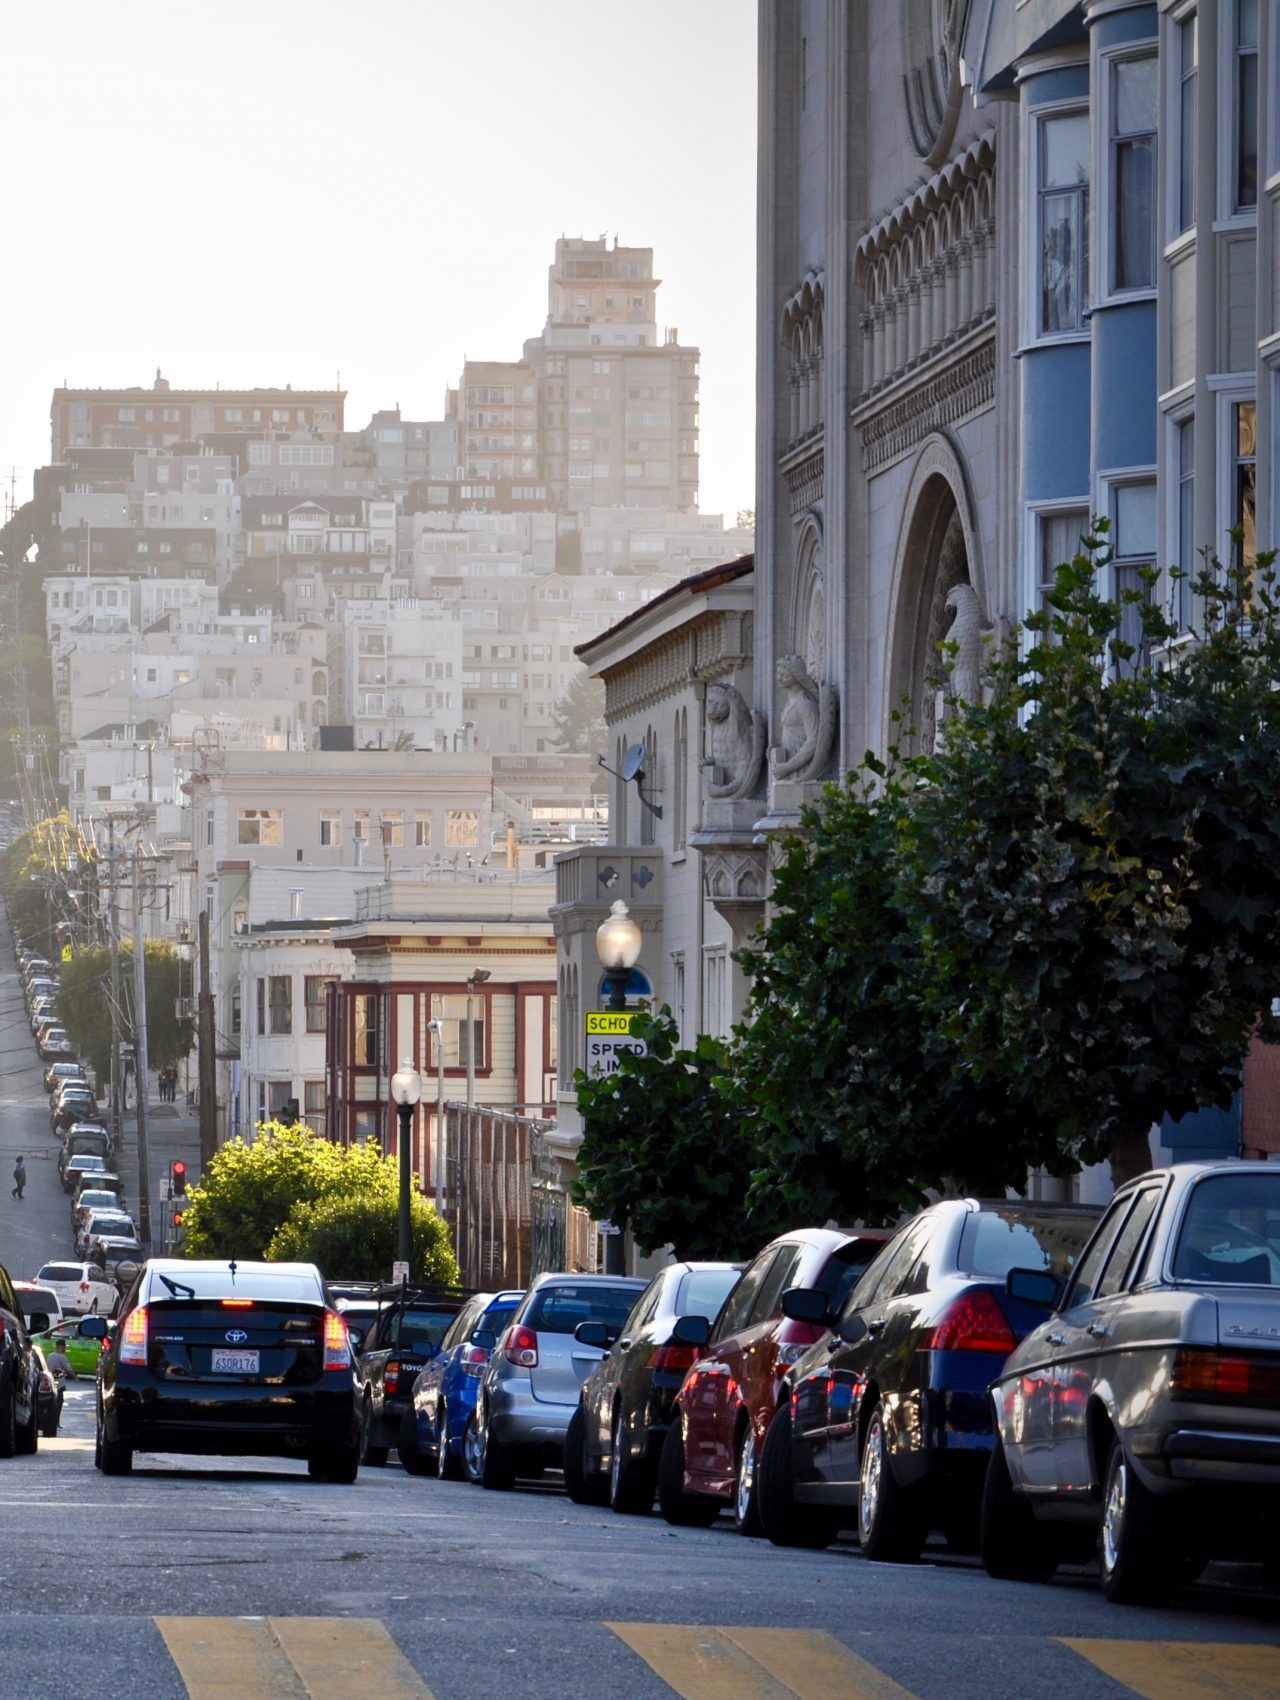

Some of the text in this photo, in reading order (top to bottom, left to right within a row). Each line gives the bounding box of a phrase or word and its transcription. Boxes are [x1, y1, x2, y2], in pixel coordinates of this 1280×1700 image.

[590, 1017, 628, 1030] SCHO
[596, 1060, 621, 1072] LIM
[401, 1363, 424, 1372] TOYO
